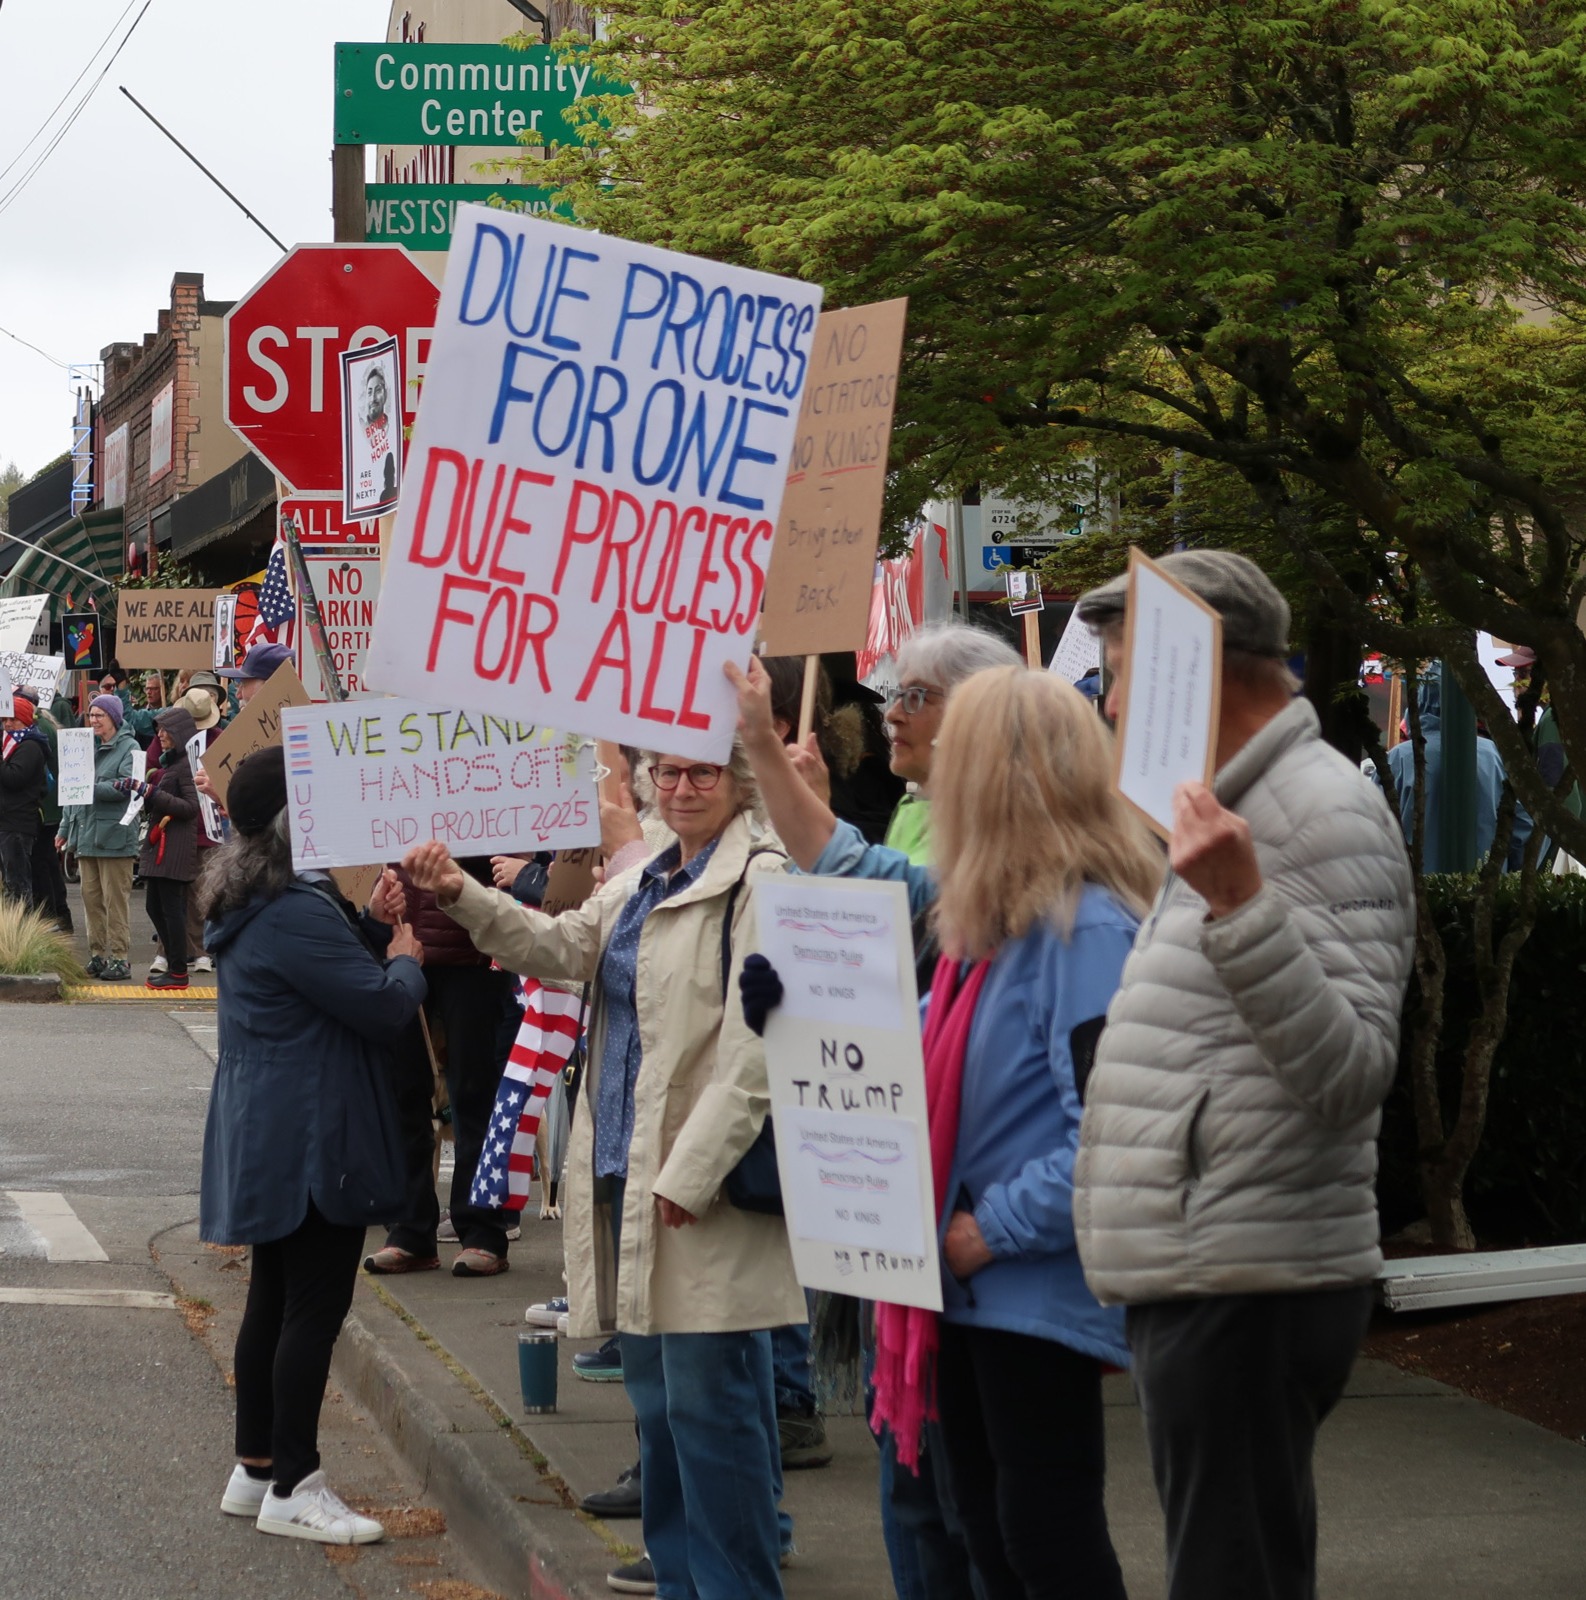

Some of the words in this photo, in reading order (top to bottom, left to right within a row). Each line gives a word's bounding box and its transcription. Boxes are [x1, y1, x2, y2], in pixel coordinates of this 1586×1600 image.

[375, 54, 591, 98] Community
[421, 99, 543, 137] Center
[366, 199, 486, 235] WESTSI
[458, 222, 600, 351] DUE
[610, 262, 814, 400] PROCESS
[824, 323, 867, 370] NO
[243, 325, 434, 414] STP
[802, 373, 895, 416] ICTATORS
[365, 415, 387, 439] BRING
[488, 342, 628, 473] FOR
[633, 379, 789, 511] ONE
[371, 439, 390, 463] HOME
[822, 421, 886, 468] KINGS
[359, 479, 373, 488] YOU
[360, 470, 372, 479] ARE
[356, 488, 376, 500] NEXT?
[291, 508, 340, 536] ALL
[408, 446, 556, 586] DUE
[551, 479, 773, 636] PROCESS
[328, 568, 363, 595] NO
[125, 601, 148, 617] WE
[153, 601, 184, 617] ARE
[190, 601, 215, 618] ALL
[307, 600, 376, 627] ARKIN
[123, 624, 216, 644] IMMIGRANT
[329, 632, 371, 650] ORT
[334, 653, 358, 671] OF
[426, 574, 559, 694] FOR
[575, 609, 712, 731] ALL
[9, 667, 58, 681] ETENTION
[326, 716, 385, 756] WE
[63, 745, 86, 759] Bring
[361, 754, 502, 801] HANDS
[371, 817, 418, 848] END
[431, 806, 525, 842] PROJECT
[530, 800, 590, 832] 2025
[775, 905, 801, 918] United
[803, 908, 829, 920] States
[842, 911, 877, 924] America
[809, 985, 823, 997] NO
[828, 986, 856, 1000] KINGS
[820, 1038, 864, 1072] NO
[835, 1209, 849, 1220] NO
[854, 1210, 881, 1225] KINGS
